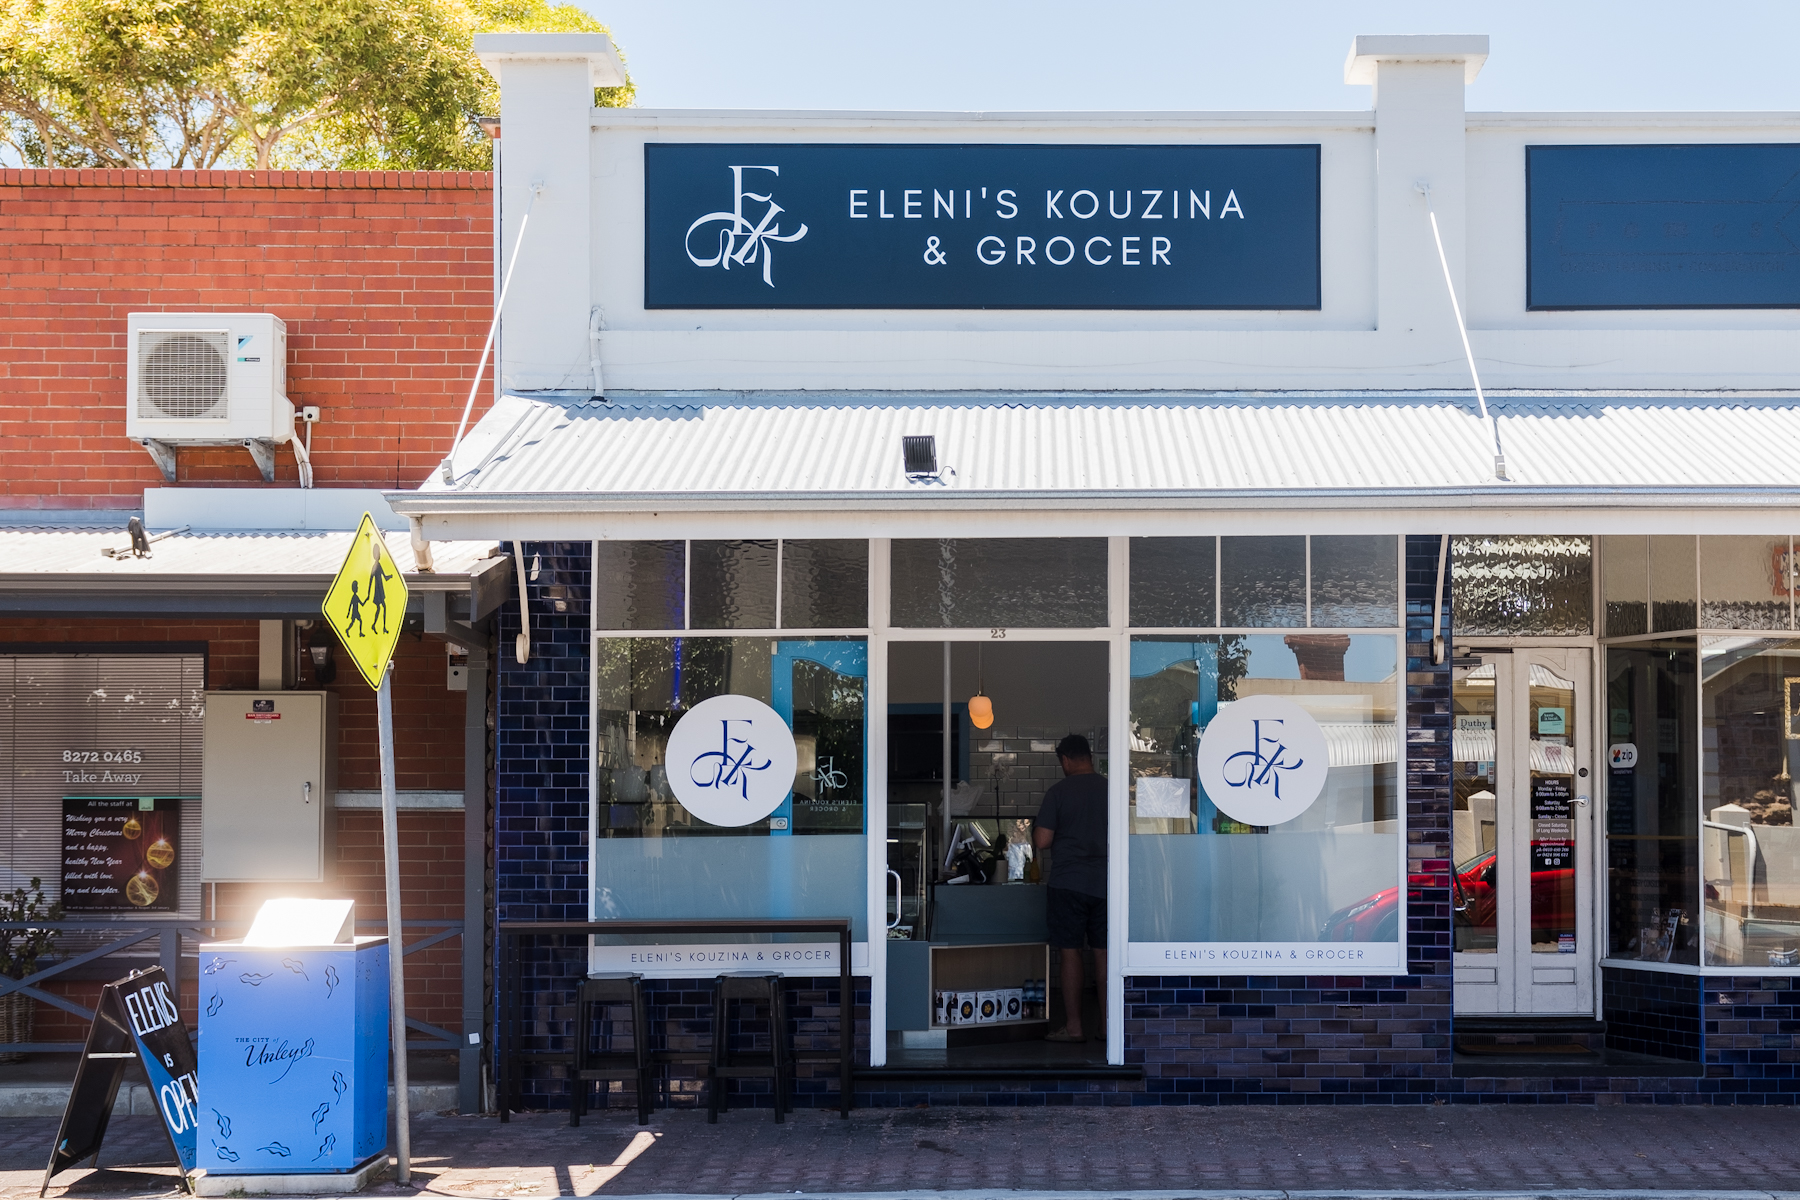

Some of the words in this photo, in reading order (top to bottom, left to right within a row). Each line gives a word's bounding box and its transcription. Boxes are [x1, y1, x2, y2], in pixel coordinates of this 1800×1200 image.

[849, 187, 1019, 220] ELENI'S
[1046, 189, 1245, 220] KOUZINA
[923, 235, 948, 266] &
[976, 235, 1173, 266] GROCER
[990, 628, 1006, 639] 23
[1460, 718, 1487, 728] Duthy
[62, 750, 100, 764] 8272
[103, 750, 142, 764] 0465
[1622, 749, 1633, 762] zip
[62, 770, 97, 783] Take
[101, 770, 142, 786] Away
[65, 814, 93, 824] Wishing
[94, 816, 106, 824] you
[114, 816, 129, 824] very
[65, 829, 88, 838] Merry
[89, 828, 123, 838] Christmas
[65, 857, 89, 866] healthy
[90, 857, 105, 865] New
[105, 857, 123, 867] Year
[65, 872, 82, 881] filled
[631, 952, 682, 963] ELENI'S
[689, 952, 749, 962] KOUZINA
[757, 951, 764, 961] &
[772, 950, 831, 961] GROCER
[1165, 950, 1216, 960] ELENI'S
[1223, 950, 1282, 960] KOUZINA
[1290, 950, 1298, 960] &
[1305, 950, 1364, 960] GROCER
[163, 1053, 174, 1068] IS
[244, 1040, 300, 1084] Unley
